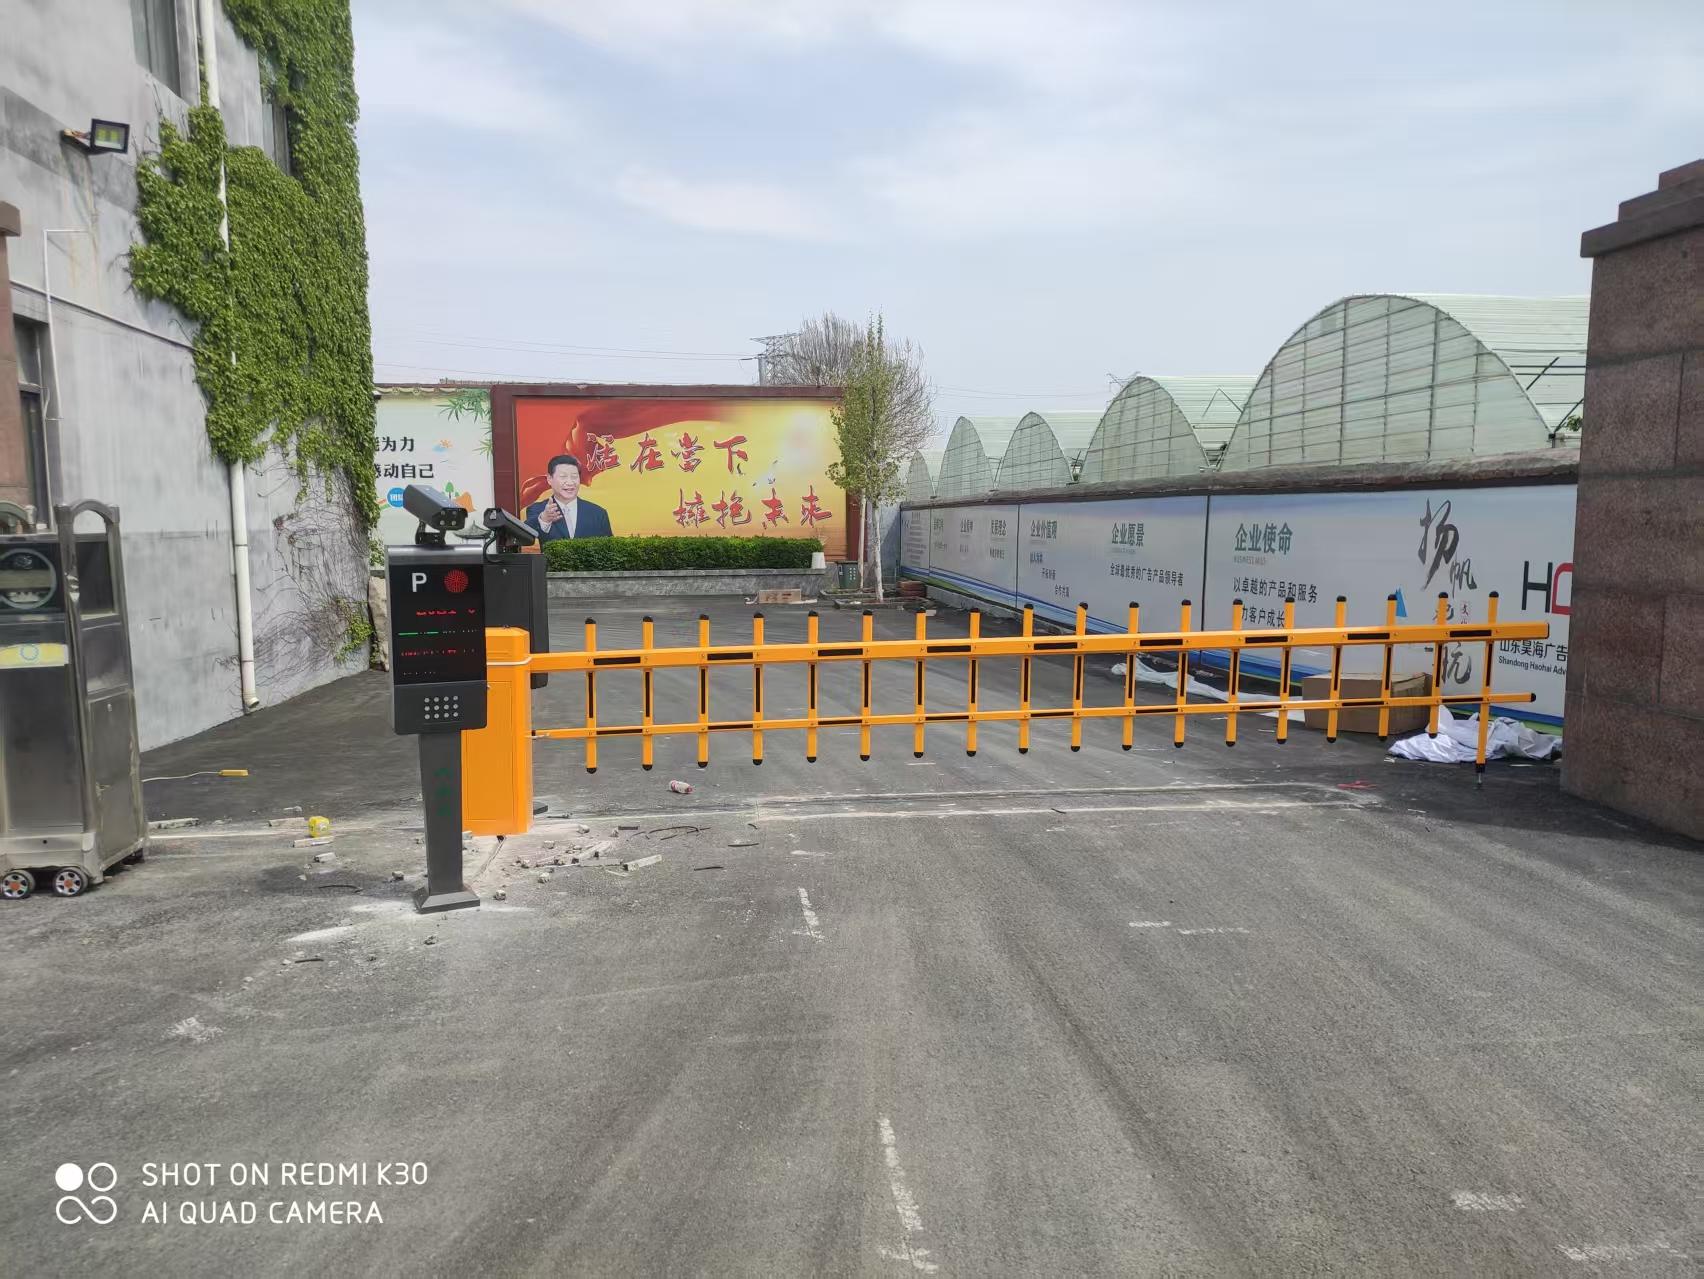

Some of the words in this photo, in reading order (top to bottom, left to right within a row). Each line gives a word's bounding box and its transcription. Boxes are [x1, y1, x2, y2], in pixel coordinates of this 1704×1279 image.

[1111, 522, 1145, 546] 企业愿景
[1234, 522, 1293, 555] 企业使命
[411, 572, 428, 592] P
[1233, 577, 1318, 604] 以卓越的产品和服务
[1498, 656, 1529, 670] Shandong
[1529, 662, 1552, 673] Haohai
